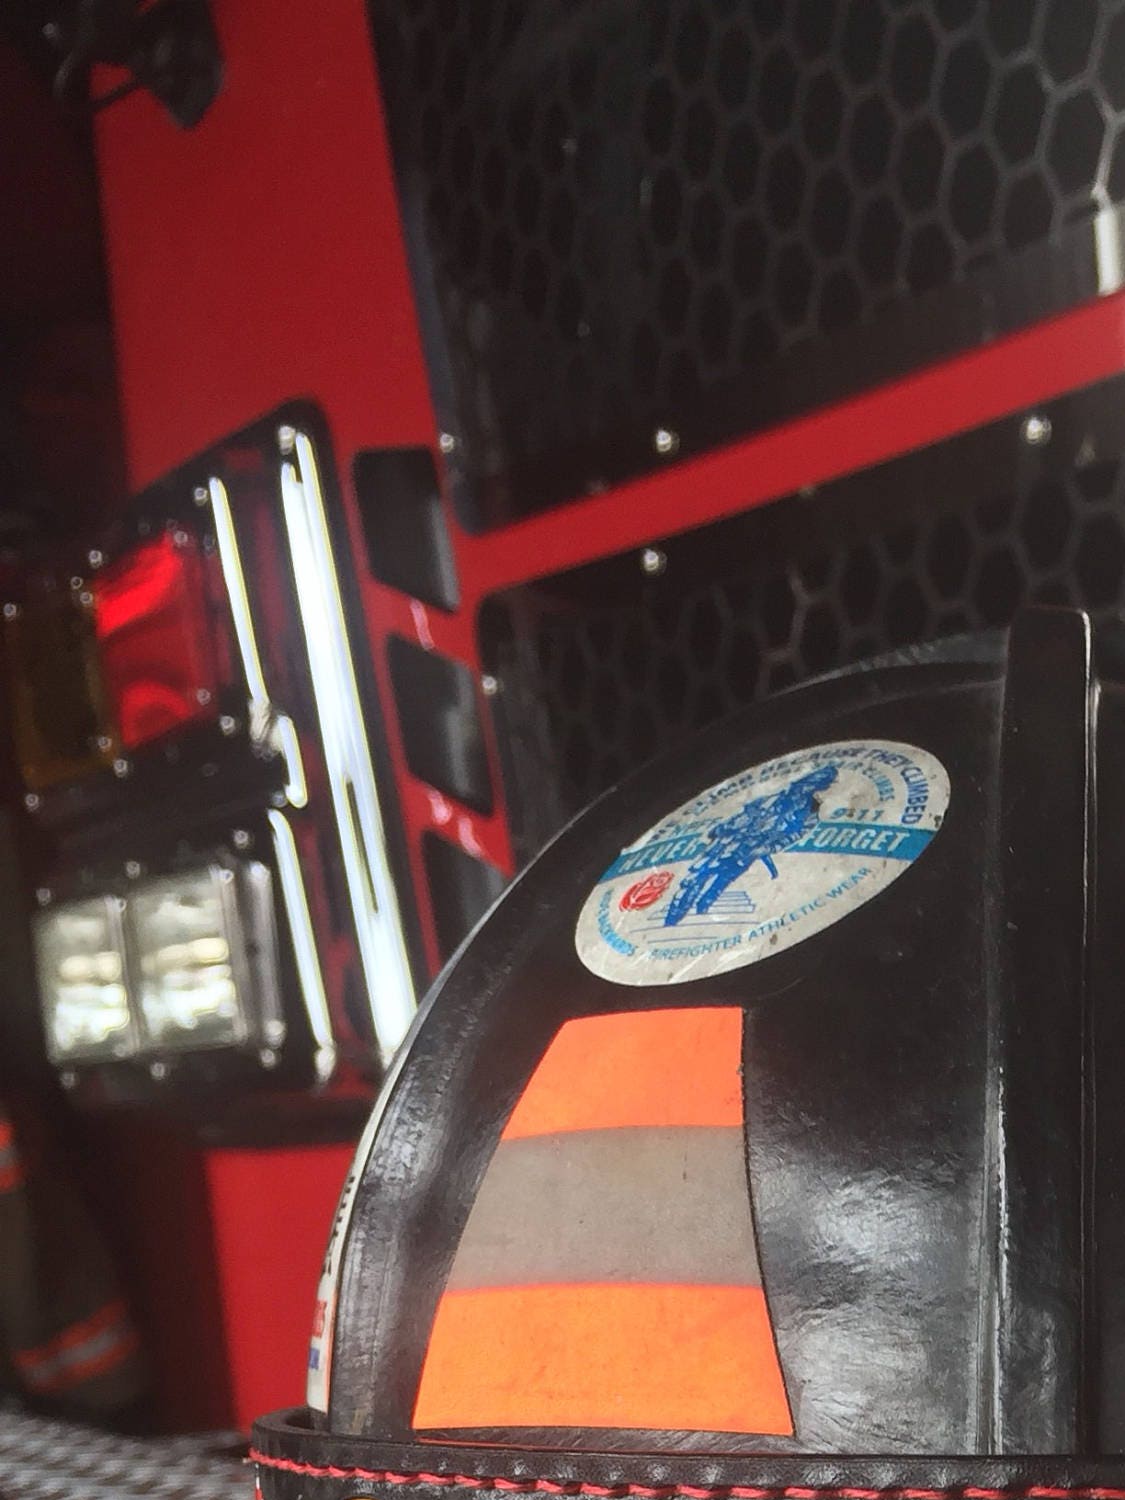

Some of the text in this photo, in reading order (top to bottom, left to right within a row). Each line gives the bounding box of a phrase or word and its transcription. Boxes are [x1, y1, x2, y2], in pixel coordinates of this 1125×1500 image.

[865, 748, 914, 768] THEY
[900, 766, 930, 824] CLIMBED
[619, 824, 911, 874] NEVER FORGET
[648, 867, 873, 960] FIREFIGHTER ATHLETIC WEAR
